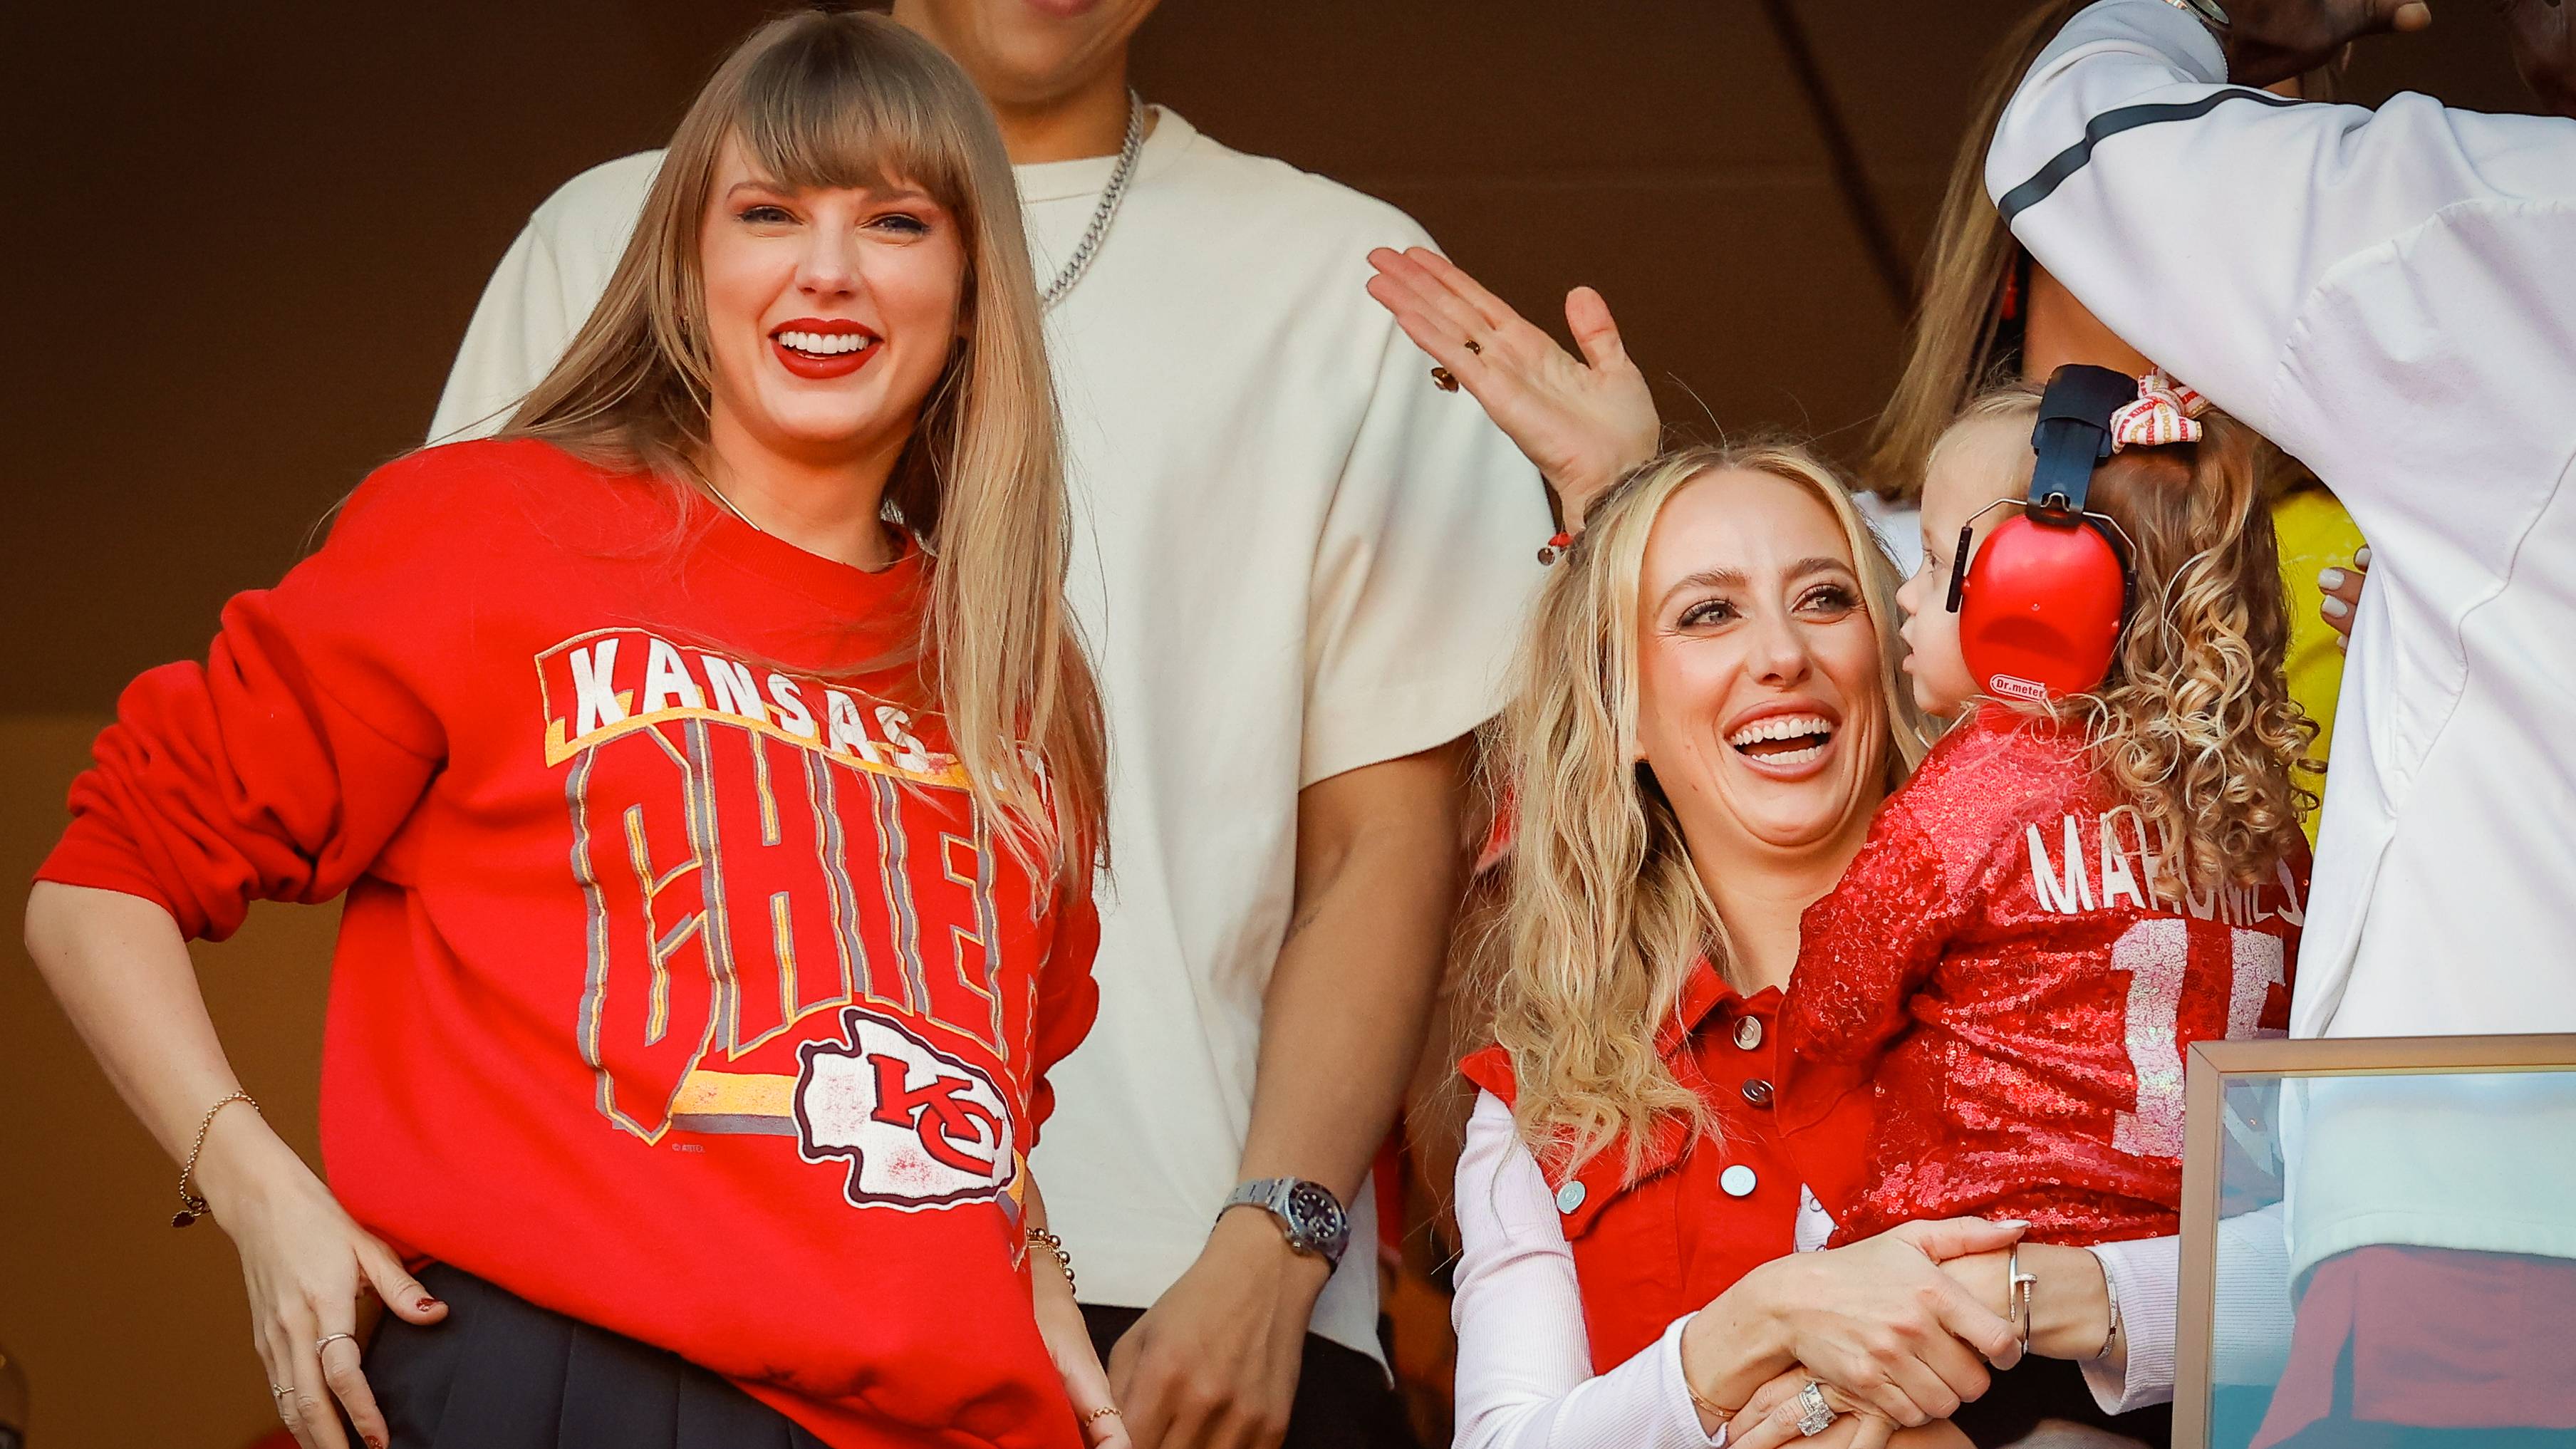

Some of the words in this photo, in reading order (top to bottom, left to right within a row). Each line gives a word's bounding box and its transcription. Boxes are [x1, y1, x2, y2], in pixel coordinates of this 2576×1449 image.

[570, 638, 927, 772] KANSAS
[1996, 678, 2043, 698] Dr.meter
[565, 716, 1008, 1148] CHIE
[866, 1053, 1004, 1179] KC
